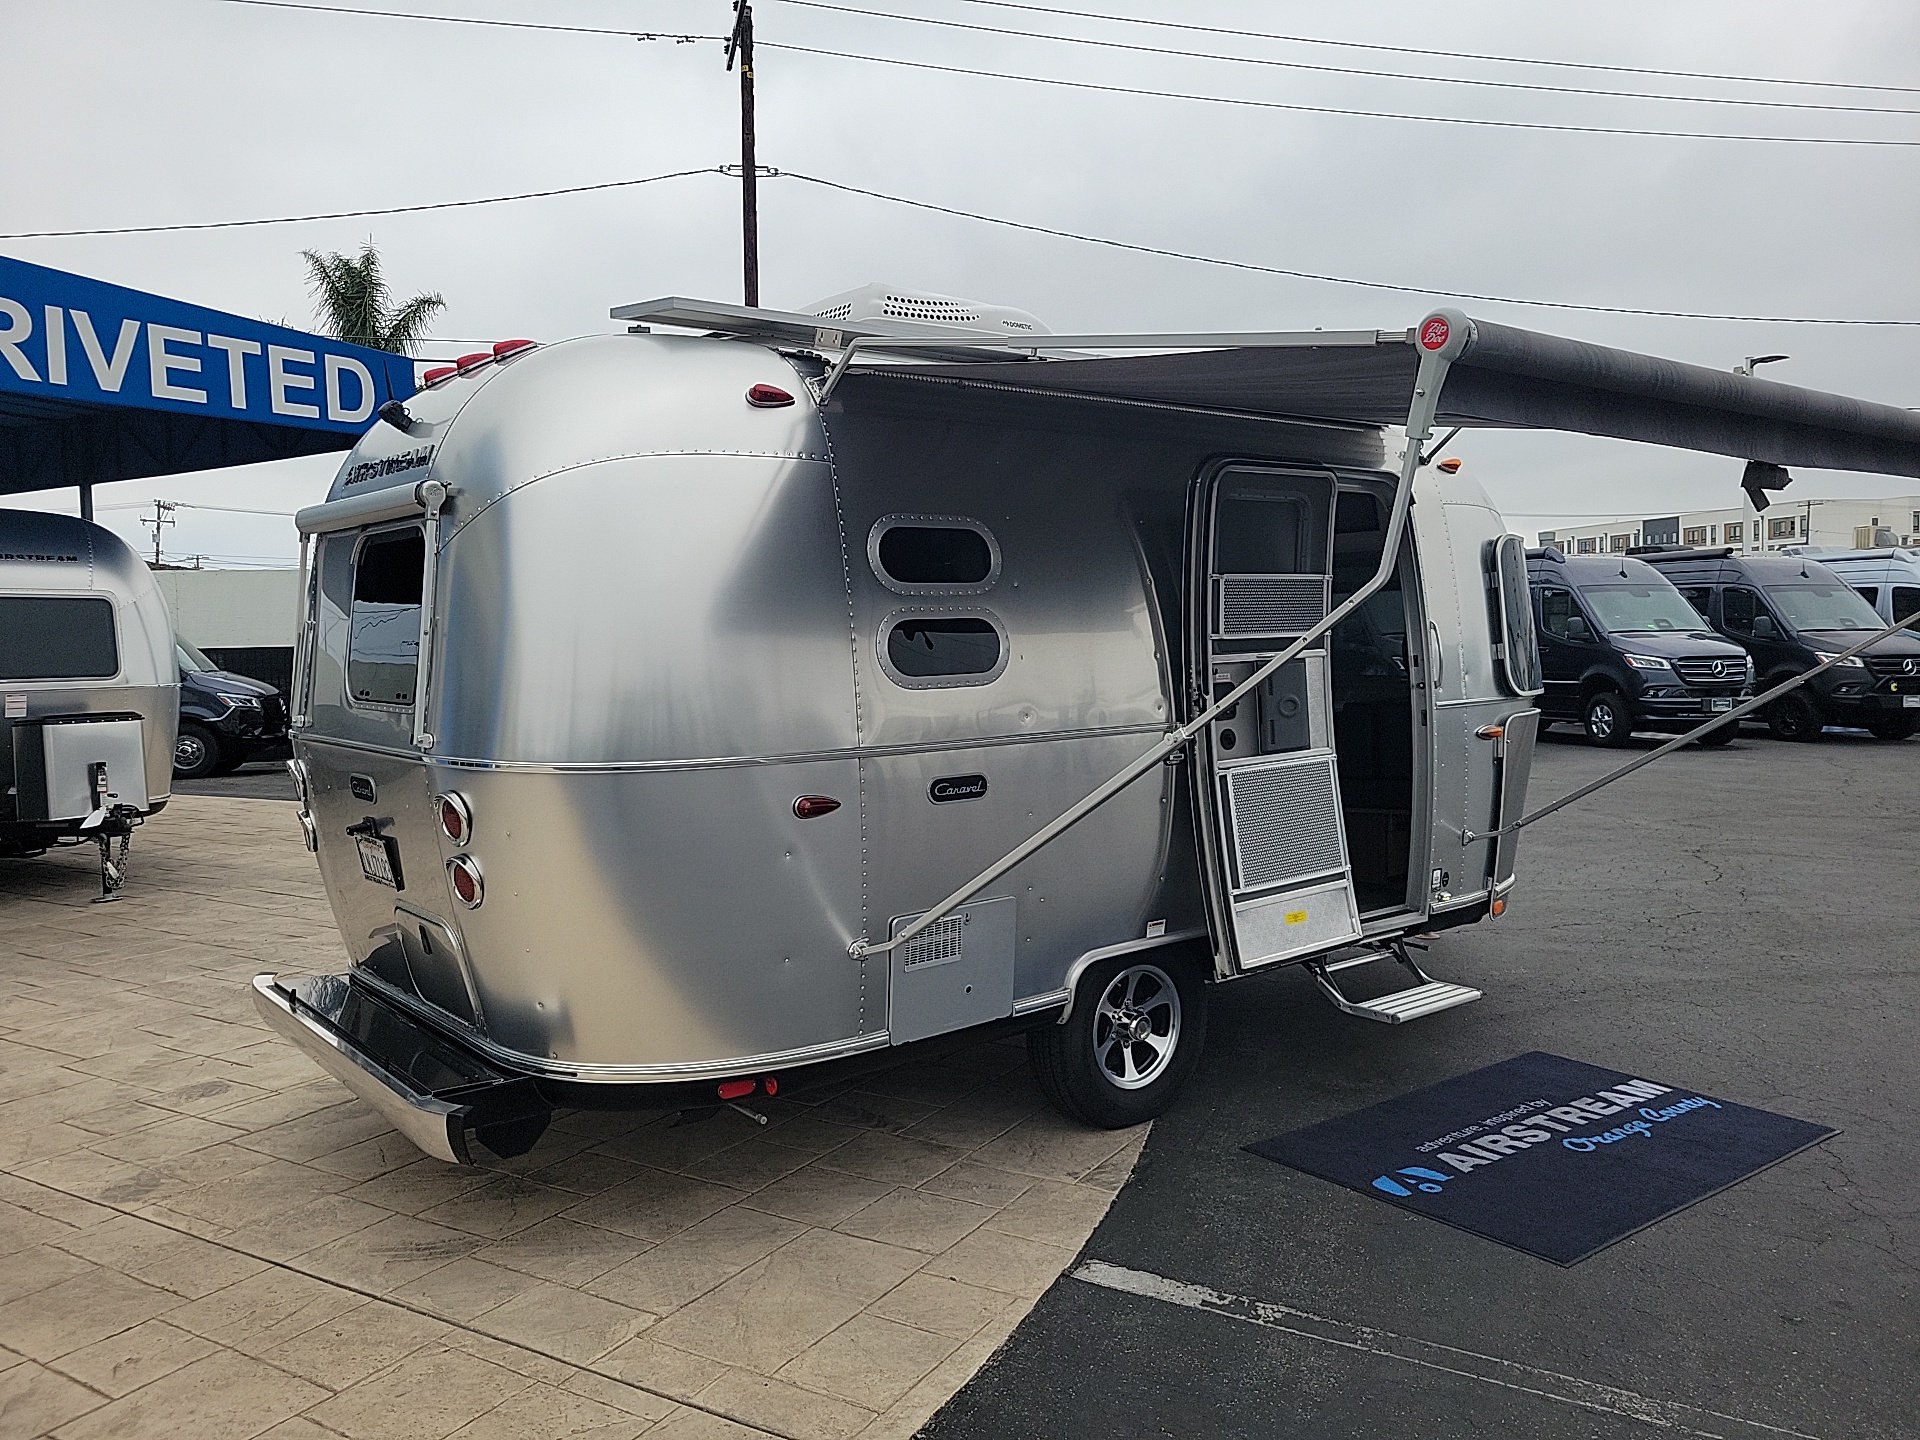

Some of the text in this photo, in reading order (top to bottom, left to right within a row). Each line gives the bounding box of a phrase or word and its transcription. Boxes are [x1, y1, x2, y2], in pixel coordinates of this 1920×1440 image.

[1423, 332, 1445, 343] Dee
[1428, 322, 1448, 335] Zip
[0, 297, 375, 423] RIVETED
[344, 443, 436, 487] AIRSTREAM
[935, 780, 986, 796] Caravel
[1414, 1099, 1553, 1153] adventure, inspired by
[1436, 1079, 1673, 1174] AIRSTREAM
[1561, 1095, 1723, 1152] Orange County
